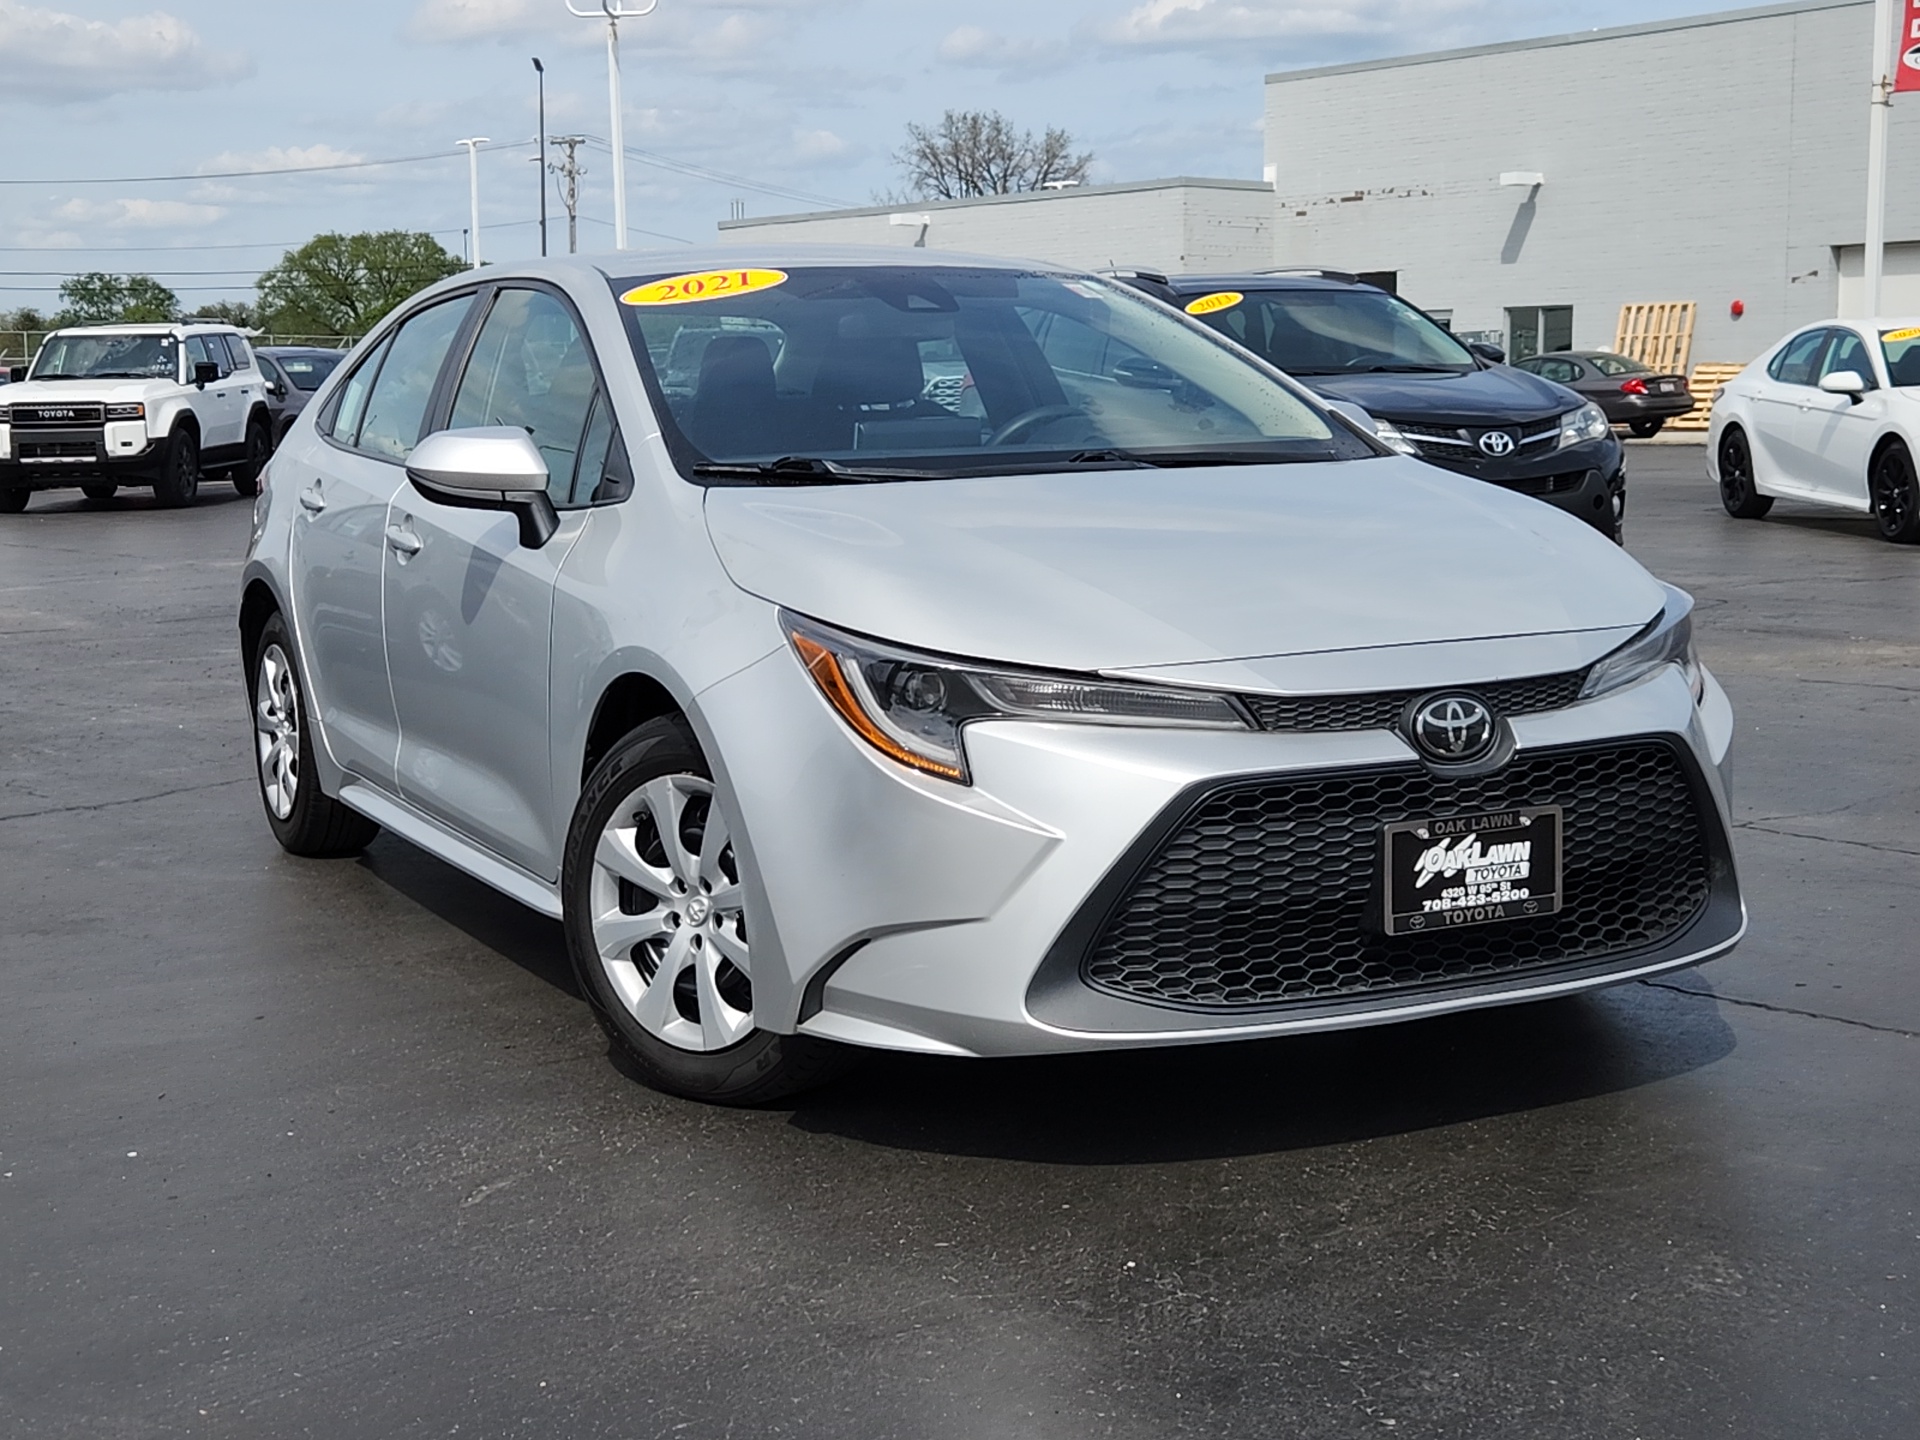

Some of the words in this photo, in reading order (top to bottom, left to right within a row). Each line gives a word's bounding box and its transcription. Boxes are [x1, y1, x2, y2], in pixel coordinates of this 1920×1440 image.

[656, 272, 751, 301] 2021
[38, 410, 75, 418] TOYOTA
[1434, 818, 1466, 834] OAK
[1471, 813, 1514, 831] LAWN
[1474, 864, 1522, 880] TOYOTA
[1422, 888, 1530, 912] 708-423-5200
[1441, 886, 1466, 899] 4320
[1467, 884, 1478, 895] W
[1442, 905, 1506, 925] TOYOTA
